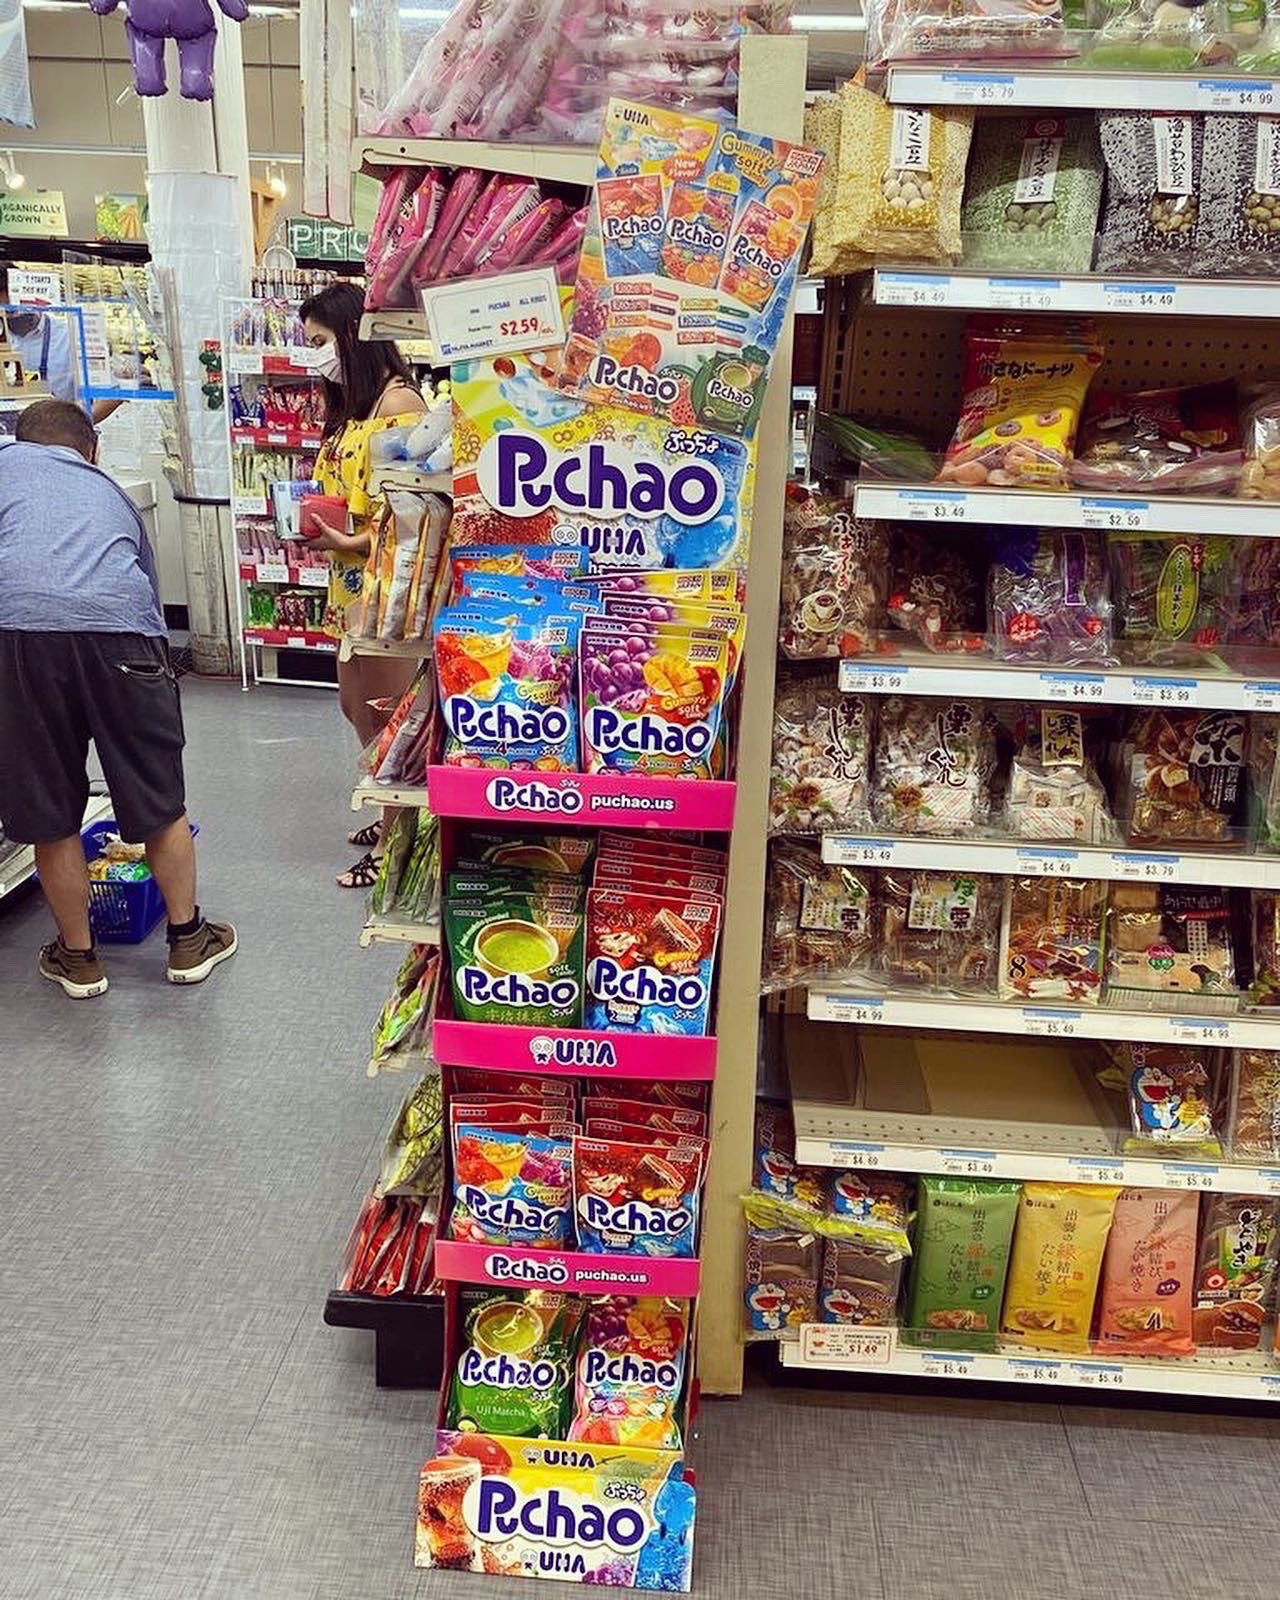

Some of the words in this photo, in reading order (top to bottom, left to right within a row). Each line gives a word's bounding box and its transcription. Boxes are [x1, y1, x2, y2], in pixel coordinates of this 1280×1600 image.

[980, 86, 1014, 98] $5.79
[1239, 92, 1273, 105] $4.99
[624, 109, 649, 126] UHA
[674, 159, 697, 169] New
[736, 156, 763, 174] soft
[2, 202, 61, 215] RGANICALLY
[4, 214, 41, 224] GROWN
[608, 217, 662, 237] Puchao
[671, 219, 724, 249] Puchao
[733, 236, 782, 277] Puchao
[1140, 294, 1173, 306] $4.49
[500, 317, 538, 336] $2.59
[595, 356, 677, 401] Puchao
[666, 431, 721, 452] ぷっちょ
[498, 435, 718, 517] Puchao
[934, 506, 964, 518] $3.49
[1109, 515, 1140, 526] $2.59
[580, 526, 646, 556] UHA
[872, 676, 901, 688] $3.99
[1073, 685, 1103, 697] $4.99
[1160, 690, 1189, 702] $3.99
[451, 698, 568, 738] Puchao
[592, 709, 710, 754] Puchao
[494, 780, 581, 811] Puchao
[591, 795, 674, 811] puchao.us
[863, 850, 891, 861] $3.49
[1043, 862, 1071, 873] $4.49
[1145, 865, 1173, 876] $3.79
[464, 968, 576, 1004] Puchao
[594, 959, 702, 1007] Puchao
[856, 1010, 882, 1020] $4.99
[1048, 1024, 1074, 1034] $5.49
[1203, 1029, 1229, 1039] $4.99
[555, 1039, 616, 1065] UHA
[1187, 1176, 1213, 1187] $5.49
[587, 1198, 688, 1233] Puchao
[491, 1256, 567, 1282] Puchao
[575, 1269, 647, 1283] puchao.us
[462, 1350, 555, 1386] Puchao
[585, 1351, 678, 1386] Puchao
[944, 1365, 968, 1375] $5.49
[1033, 1370, 1058, 1380] $5.49
[1098, 1374, 1123, 1384] $5.49
[492, 1406, 526, 1417] Matcha
[543, 1449, 596, 1468] UHA
[478, 1479, 644, 1546] Puchao
[539, 1551, 586, 1574] UHA
